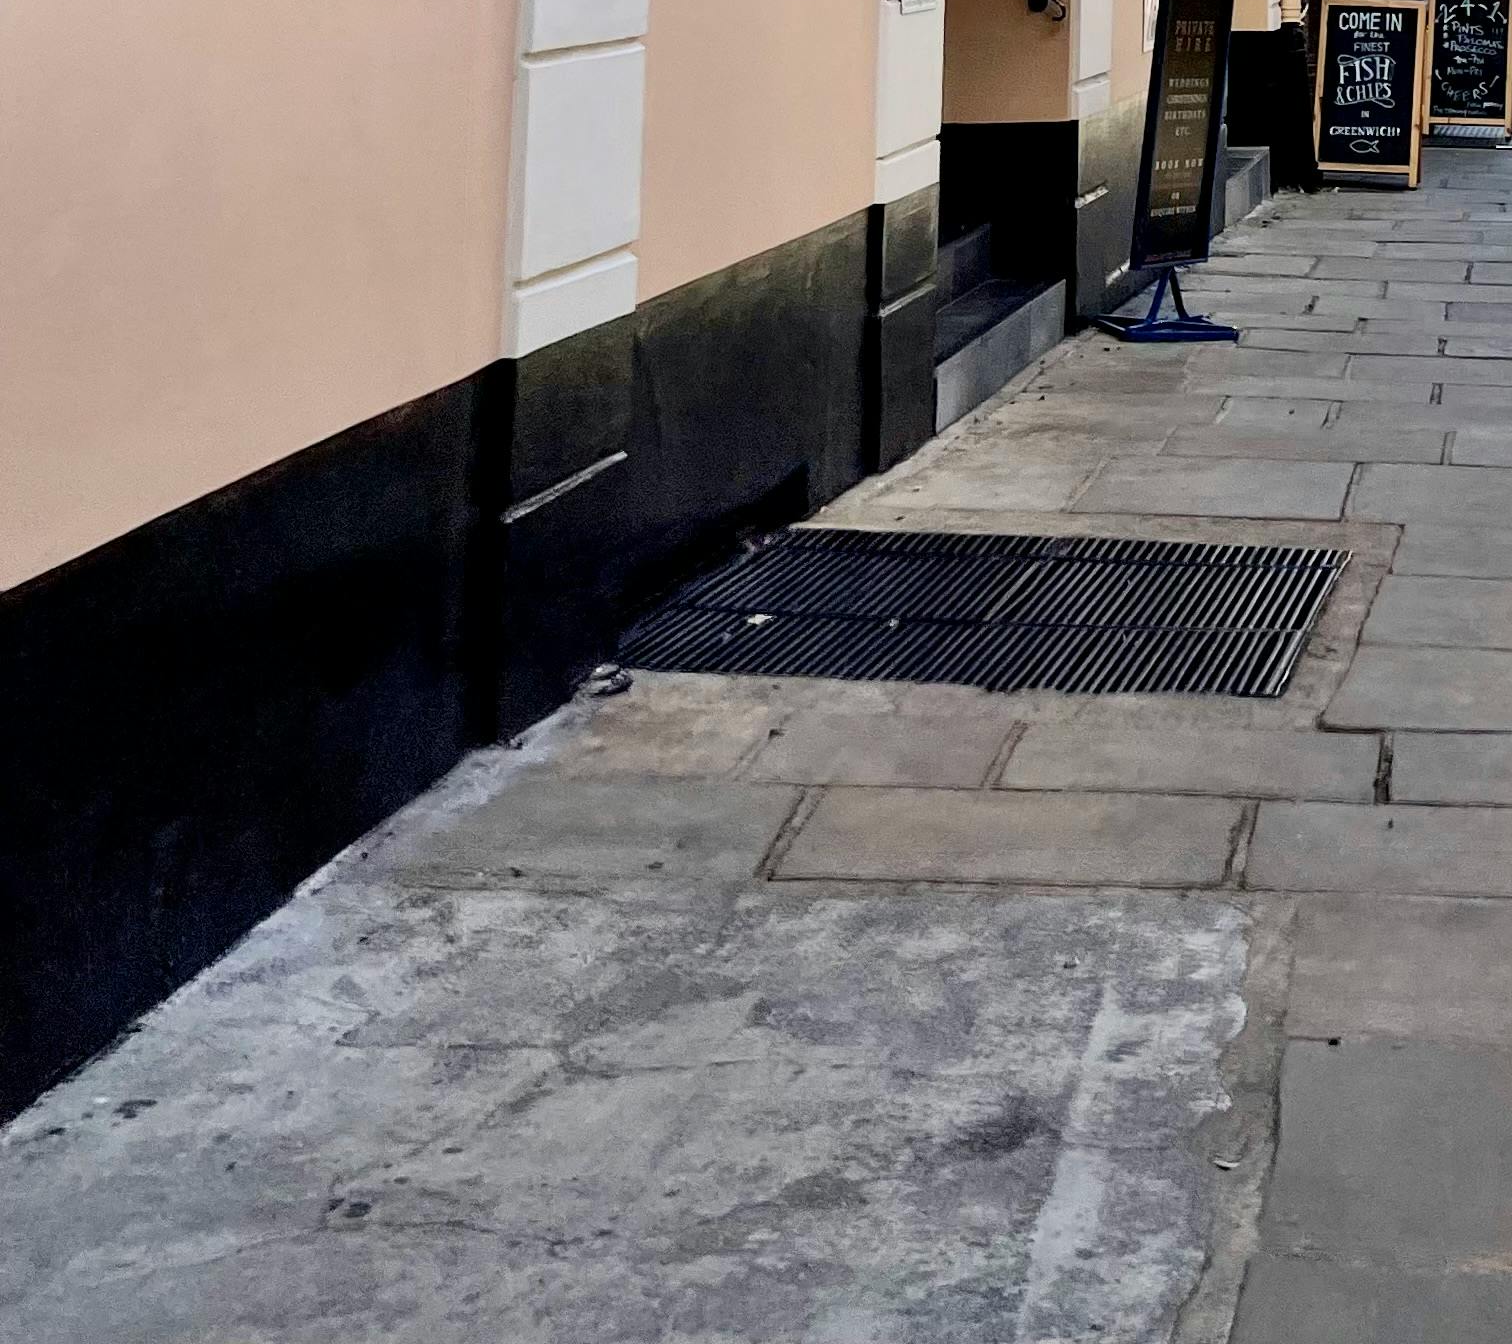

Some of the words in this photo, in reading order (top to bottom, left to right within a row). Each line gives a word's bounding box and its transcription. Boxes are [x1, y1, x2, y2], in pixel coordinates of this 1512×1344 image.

[1338, 11, 1382, 31] COME
[1385, 13, 1403, 32] IN
[1451, 20, 1485, 36] PINTS
[1353, 41, 1391, 53] FINEST
[1450, 40, 1498, 56] PROSECCO
[1338, 56, 1391, 85] FISH
[1441, 81, 1489, 102] CHEERS
